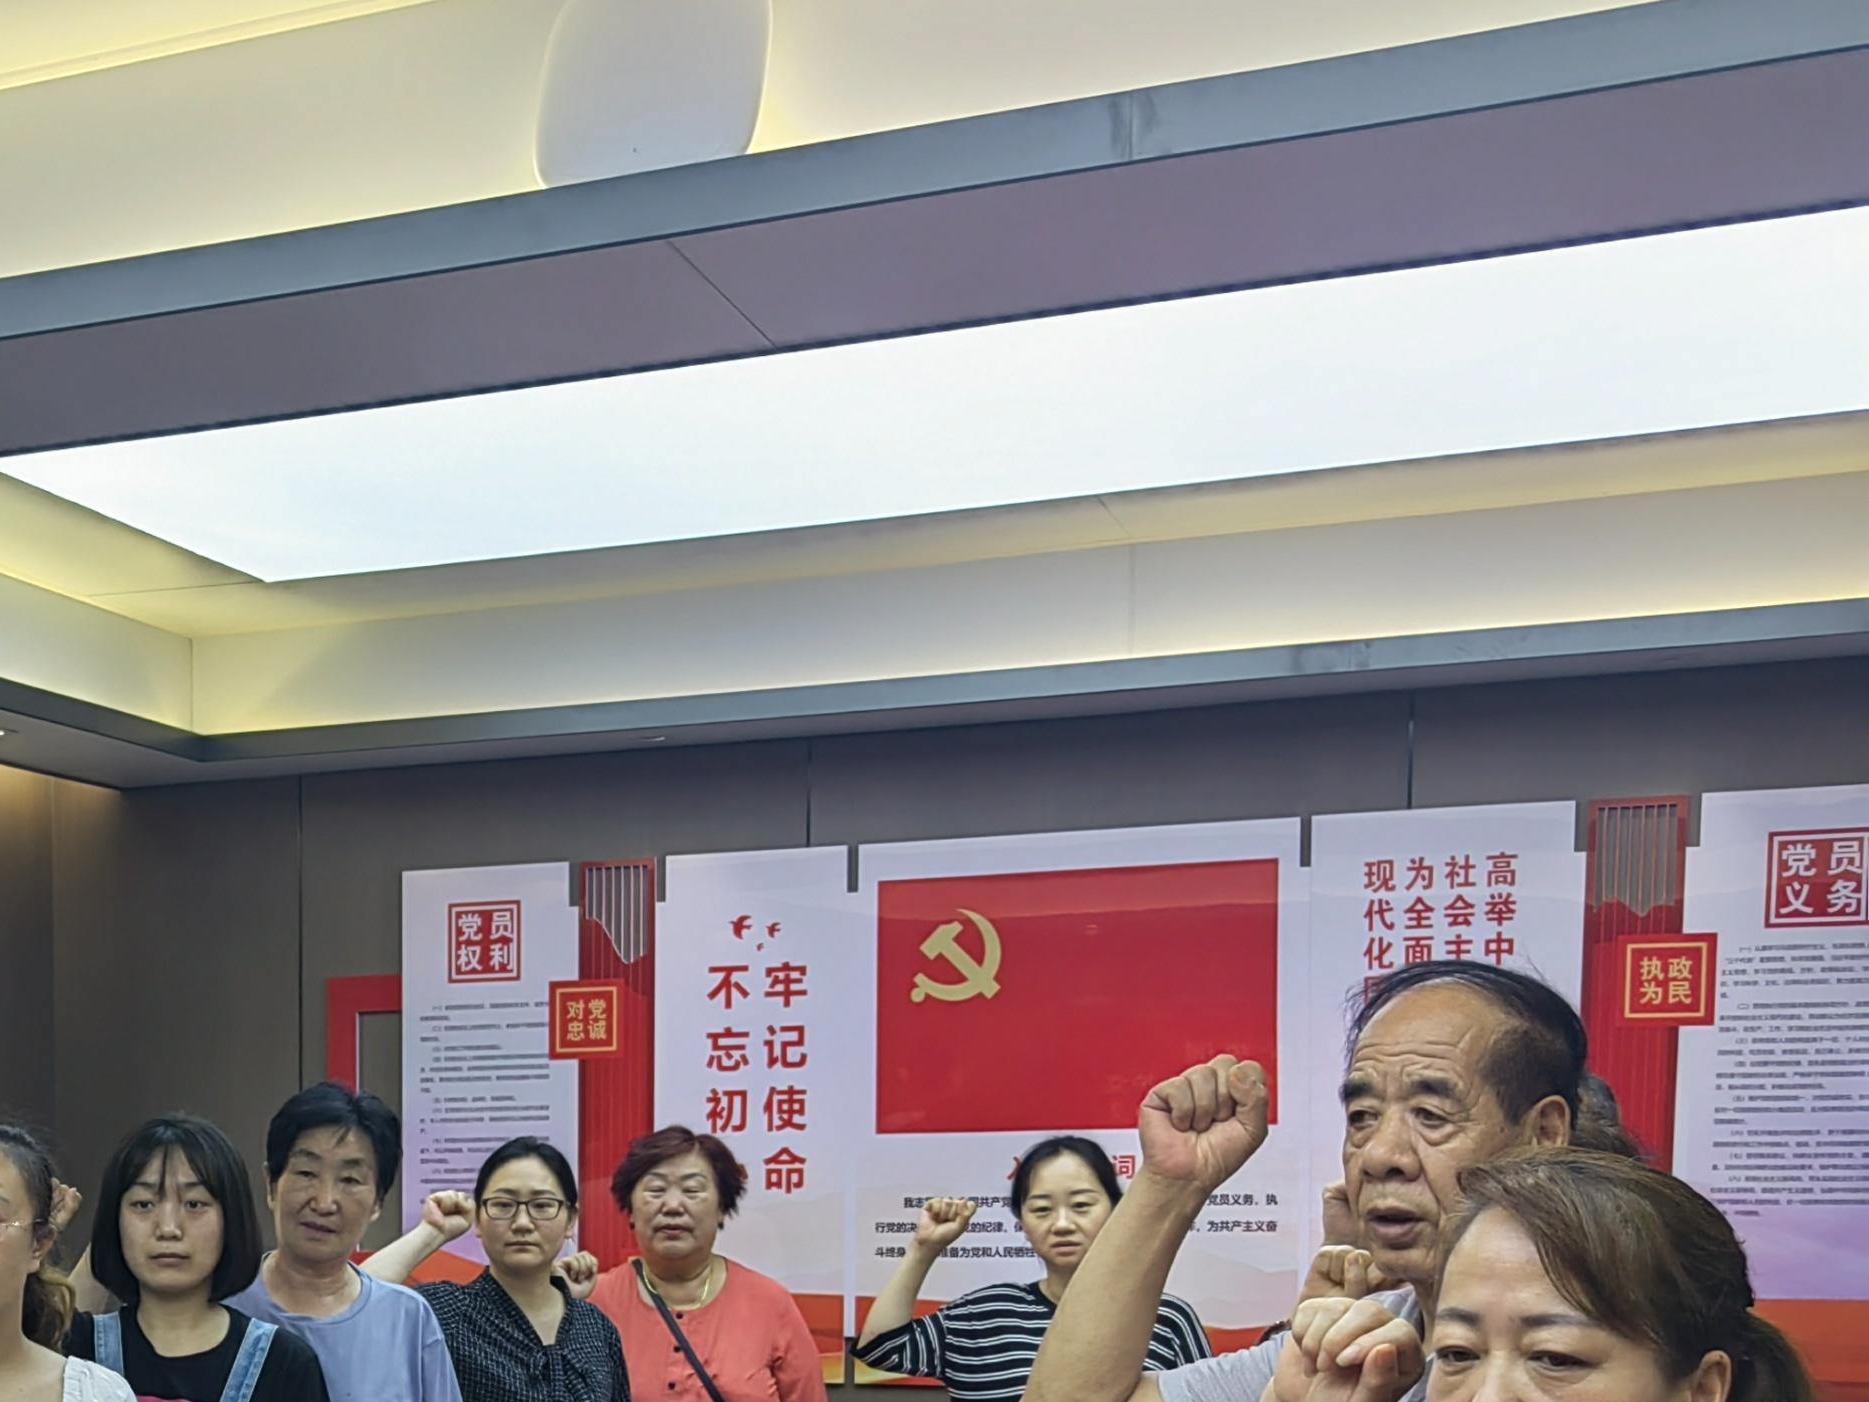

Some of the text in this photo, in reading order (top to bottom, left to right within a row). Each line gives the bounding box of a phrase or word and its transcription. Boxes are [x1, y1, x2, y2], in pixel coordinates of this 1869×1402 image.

[1780, 841, 1863, 878] 党员
[1779, 879, 1863, 915] 义务
[457, 911, 514, 942] 党员
[457, 942, 514, 972] 权利
[1639, 956, 1693, 981] 执政
[1639, 982, 1693, 1005] 为民
[566, 998, 607, 1020] 对党
[566, 1020, 607, 1041] 忠诚
[706, 965, 751, 1180] 不忘初
[763, 961, 808, 1194] 牢记使命
